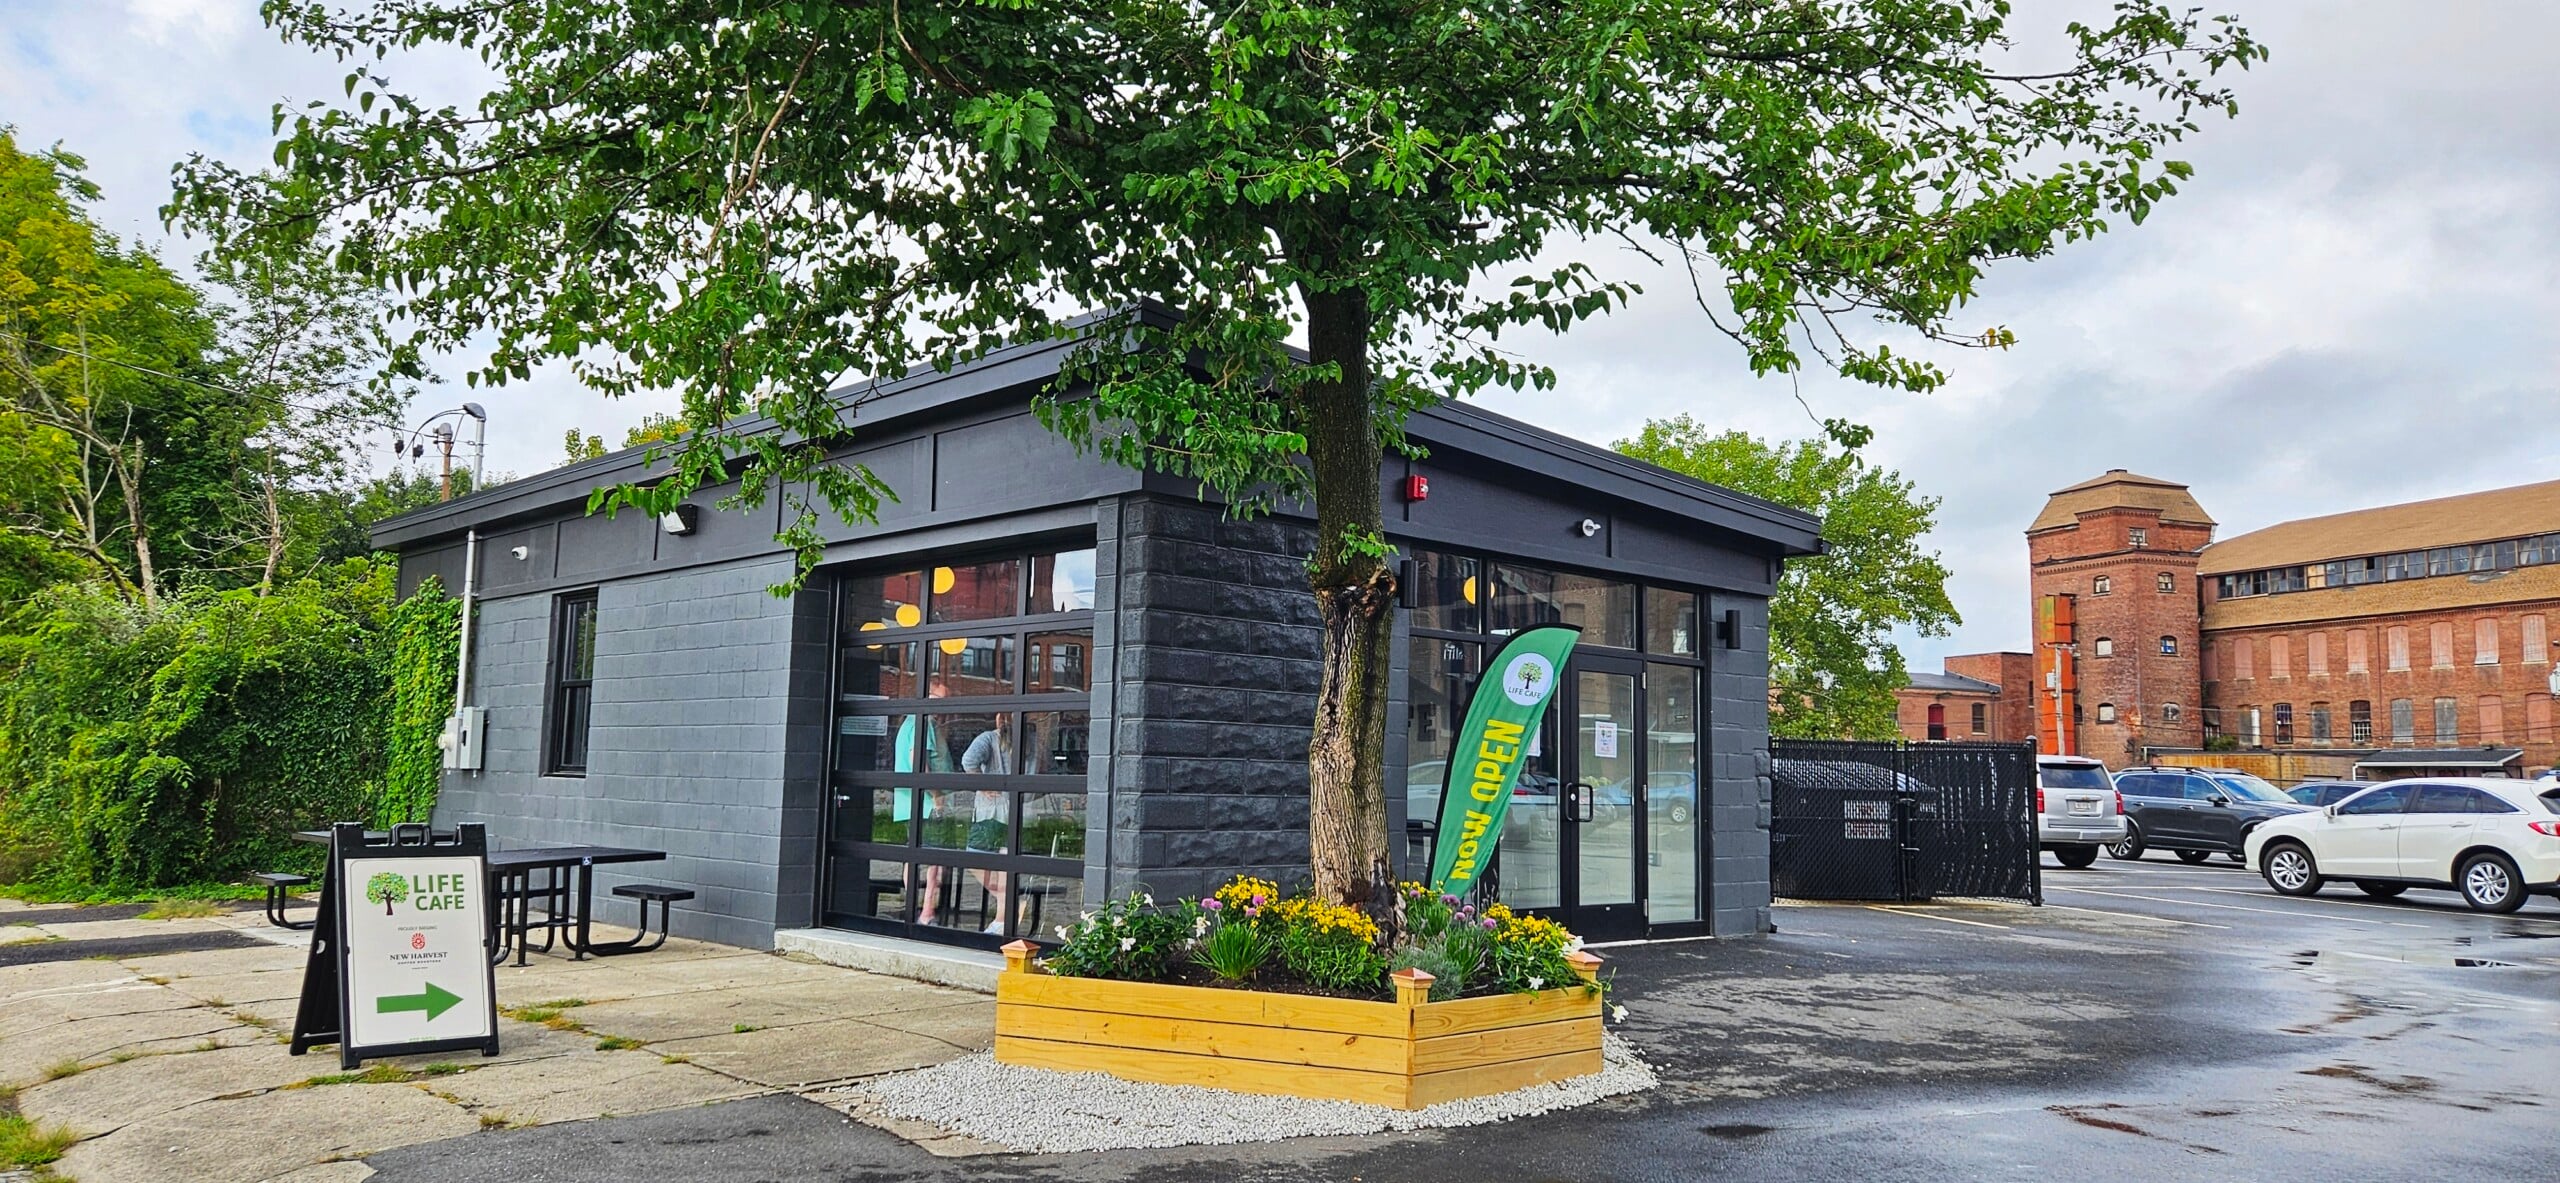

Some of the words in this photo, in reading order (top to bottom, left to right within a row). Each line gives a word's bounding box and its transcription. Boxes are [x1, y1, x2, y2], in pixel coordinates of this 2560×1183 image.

[1508, 686, 1523, 695] LIFE
[1524, 690, 1542, 699] CAFE
[1470, 719, 1525, 802] OPEN
[1450, 809, 1492, 881] NOW
[413, 874, 465, 893] LIFE
[415, 895, 465, 911] CAFE
[411, 951, 448, 959] HARVEST
